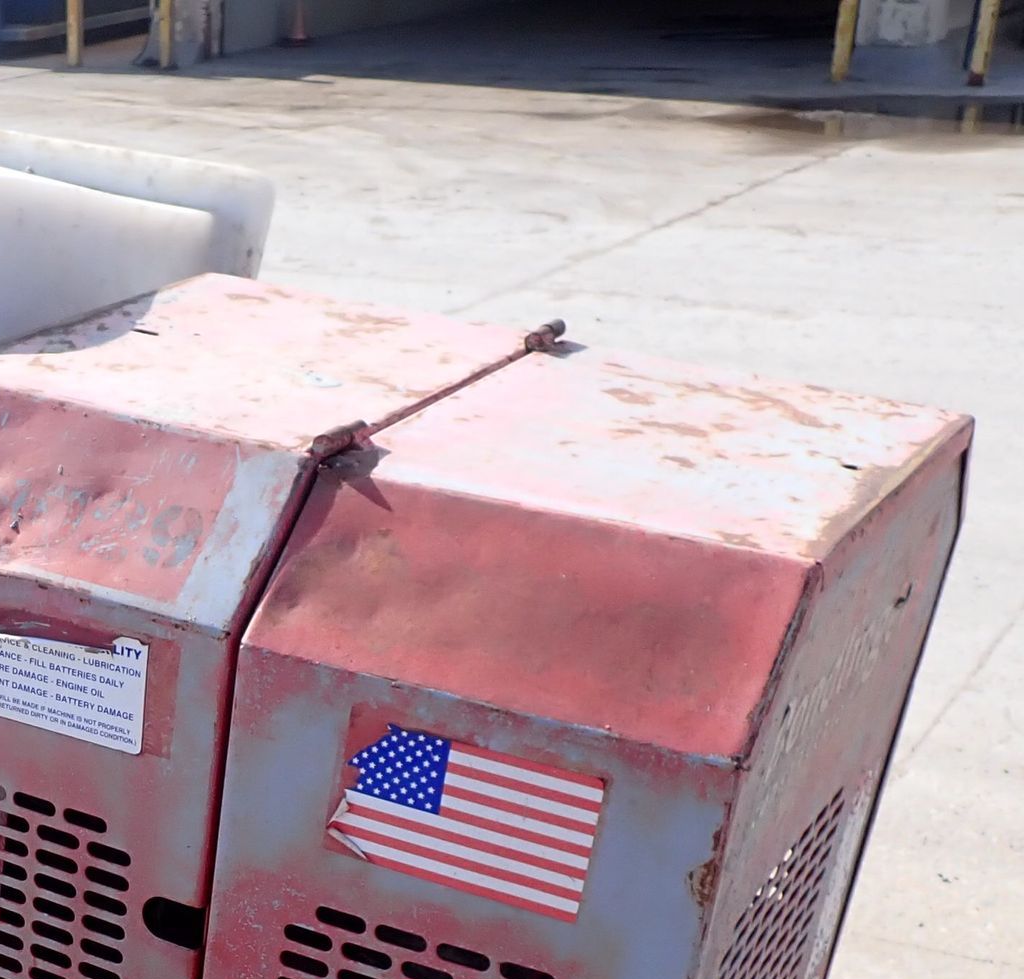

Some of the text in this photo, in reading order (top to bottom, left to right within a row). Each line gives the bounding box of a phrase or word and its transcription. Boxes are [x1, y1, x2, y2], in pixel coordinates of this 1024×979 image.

[31, 644, 76, 661] CLEANING
[83, 657, 141, 678] LUBRICATION
[113, 644, 142, 660] LITY
[12, 667, 49, 684] DAMAGE
[56, 678, 89, 694] ENGINE
[90, 688, 105, 699] OIL
[29, 657, 47, 669] FILL
[49, 662, 97, 682] BATTERIES
[99, 676, 125, 689] DAILY
[11, 681, 48, 698] DAMAGE
[55, 693, 95, 710] BATTERY
[97, 705, 135, 721] DAMAGE
[12, 697, 21, 705] BE
[22, 700, 39, 709] MADE
[47, 707, 75, 721] MACHINE
[83, 717, 97, 726] NOT
[97, 721, 131, 736] PROPERLY
[30, 710, 49, 720] DIRTY
[67, 721, 99, 735] DAMAGED
